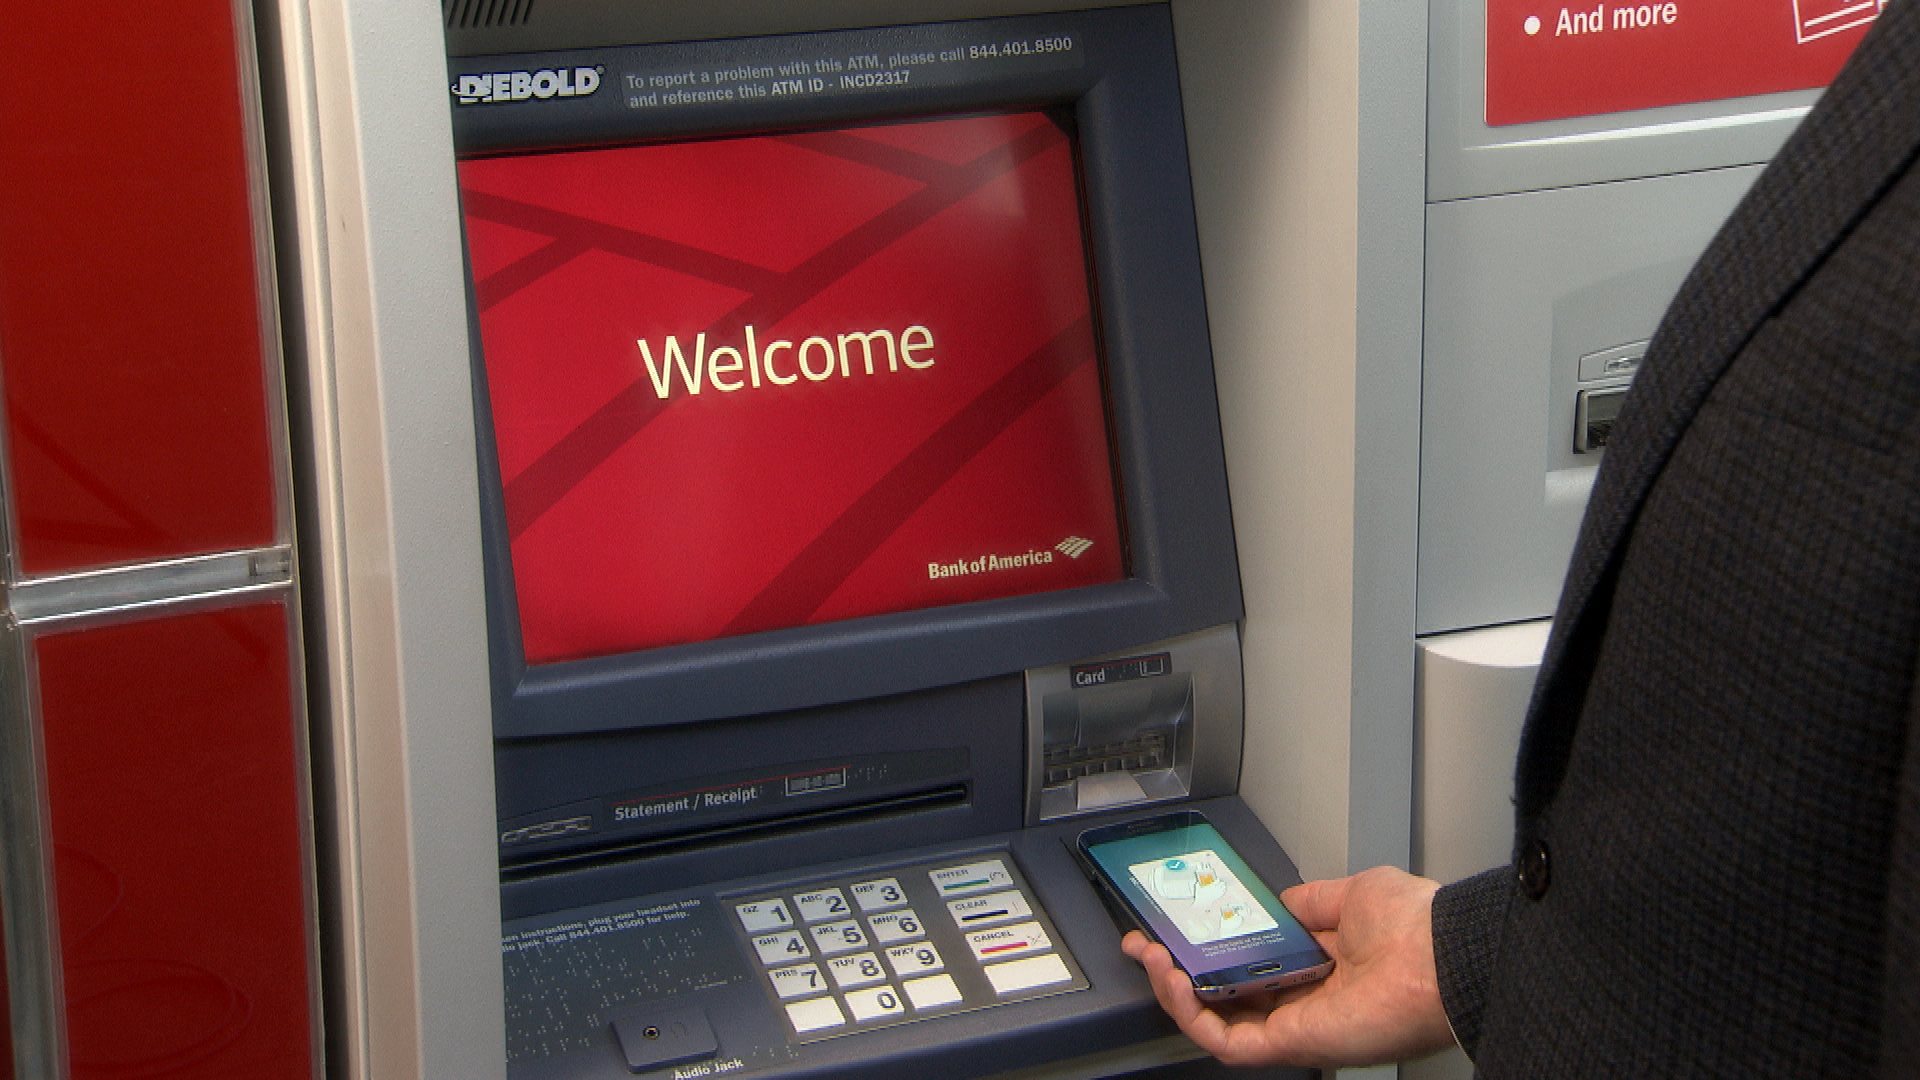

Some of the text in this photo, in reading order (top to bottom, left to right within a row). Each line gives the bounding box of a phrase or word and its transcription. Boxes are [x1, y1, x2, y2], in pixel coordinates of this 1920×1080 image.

[1555, 2, 1678, 36] And more
[627, 37, 1073, 89] To report a problem with this ATM, please call 844.401.8500
[452, 66, 601, 104] DIEBOLD
[629, 93, 657, 109] and
[662, 88, 734, 105] reference
[738, 84, 767, 99] this
[771, 80, 803, 96] ATM
[808, 77, 824, 92] ID
[839, 70, 911, 89] INCD2317
[637, 325, 935, 399] Welcome
[928, 550, 1053, 579] Bank of America
[1075, 668, 1105, 685] Card
[615, 787, 758, 820] Statement / Receipt
[936, 869, 969, 879] ENTER
[880, 885, 900, 901] 3
[636, 903, 677, 917] headset
[801, 894, 846, 912] ABC 2
[955, 899, 988, 910] CLEAR
[771, 905, 787, 922] 1
[899, 917, 918, 933] 6
[545, 933, 567, 943] Call
[842, 926, 862, 943] 5
[973, 930, 1015, 942] CANCEL
[787, 938, 804, 954] 4
[916, 949, 935, 965] 9
[860, 959, 880, 976] 8
[801, 969, 817, 988] 7
[877, 991, 897, 1008] 0
[673, 1057, 743, 1080] Audio Jack
